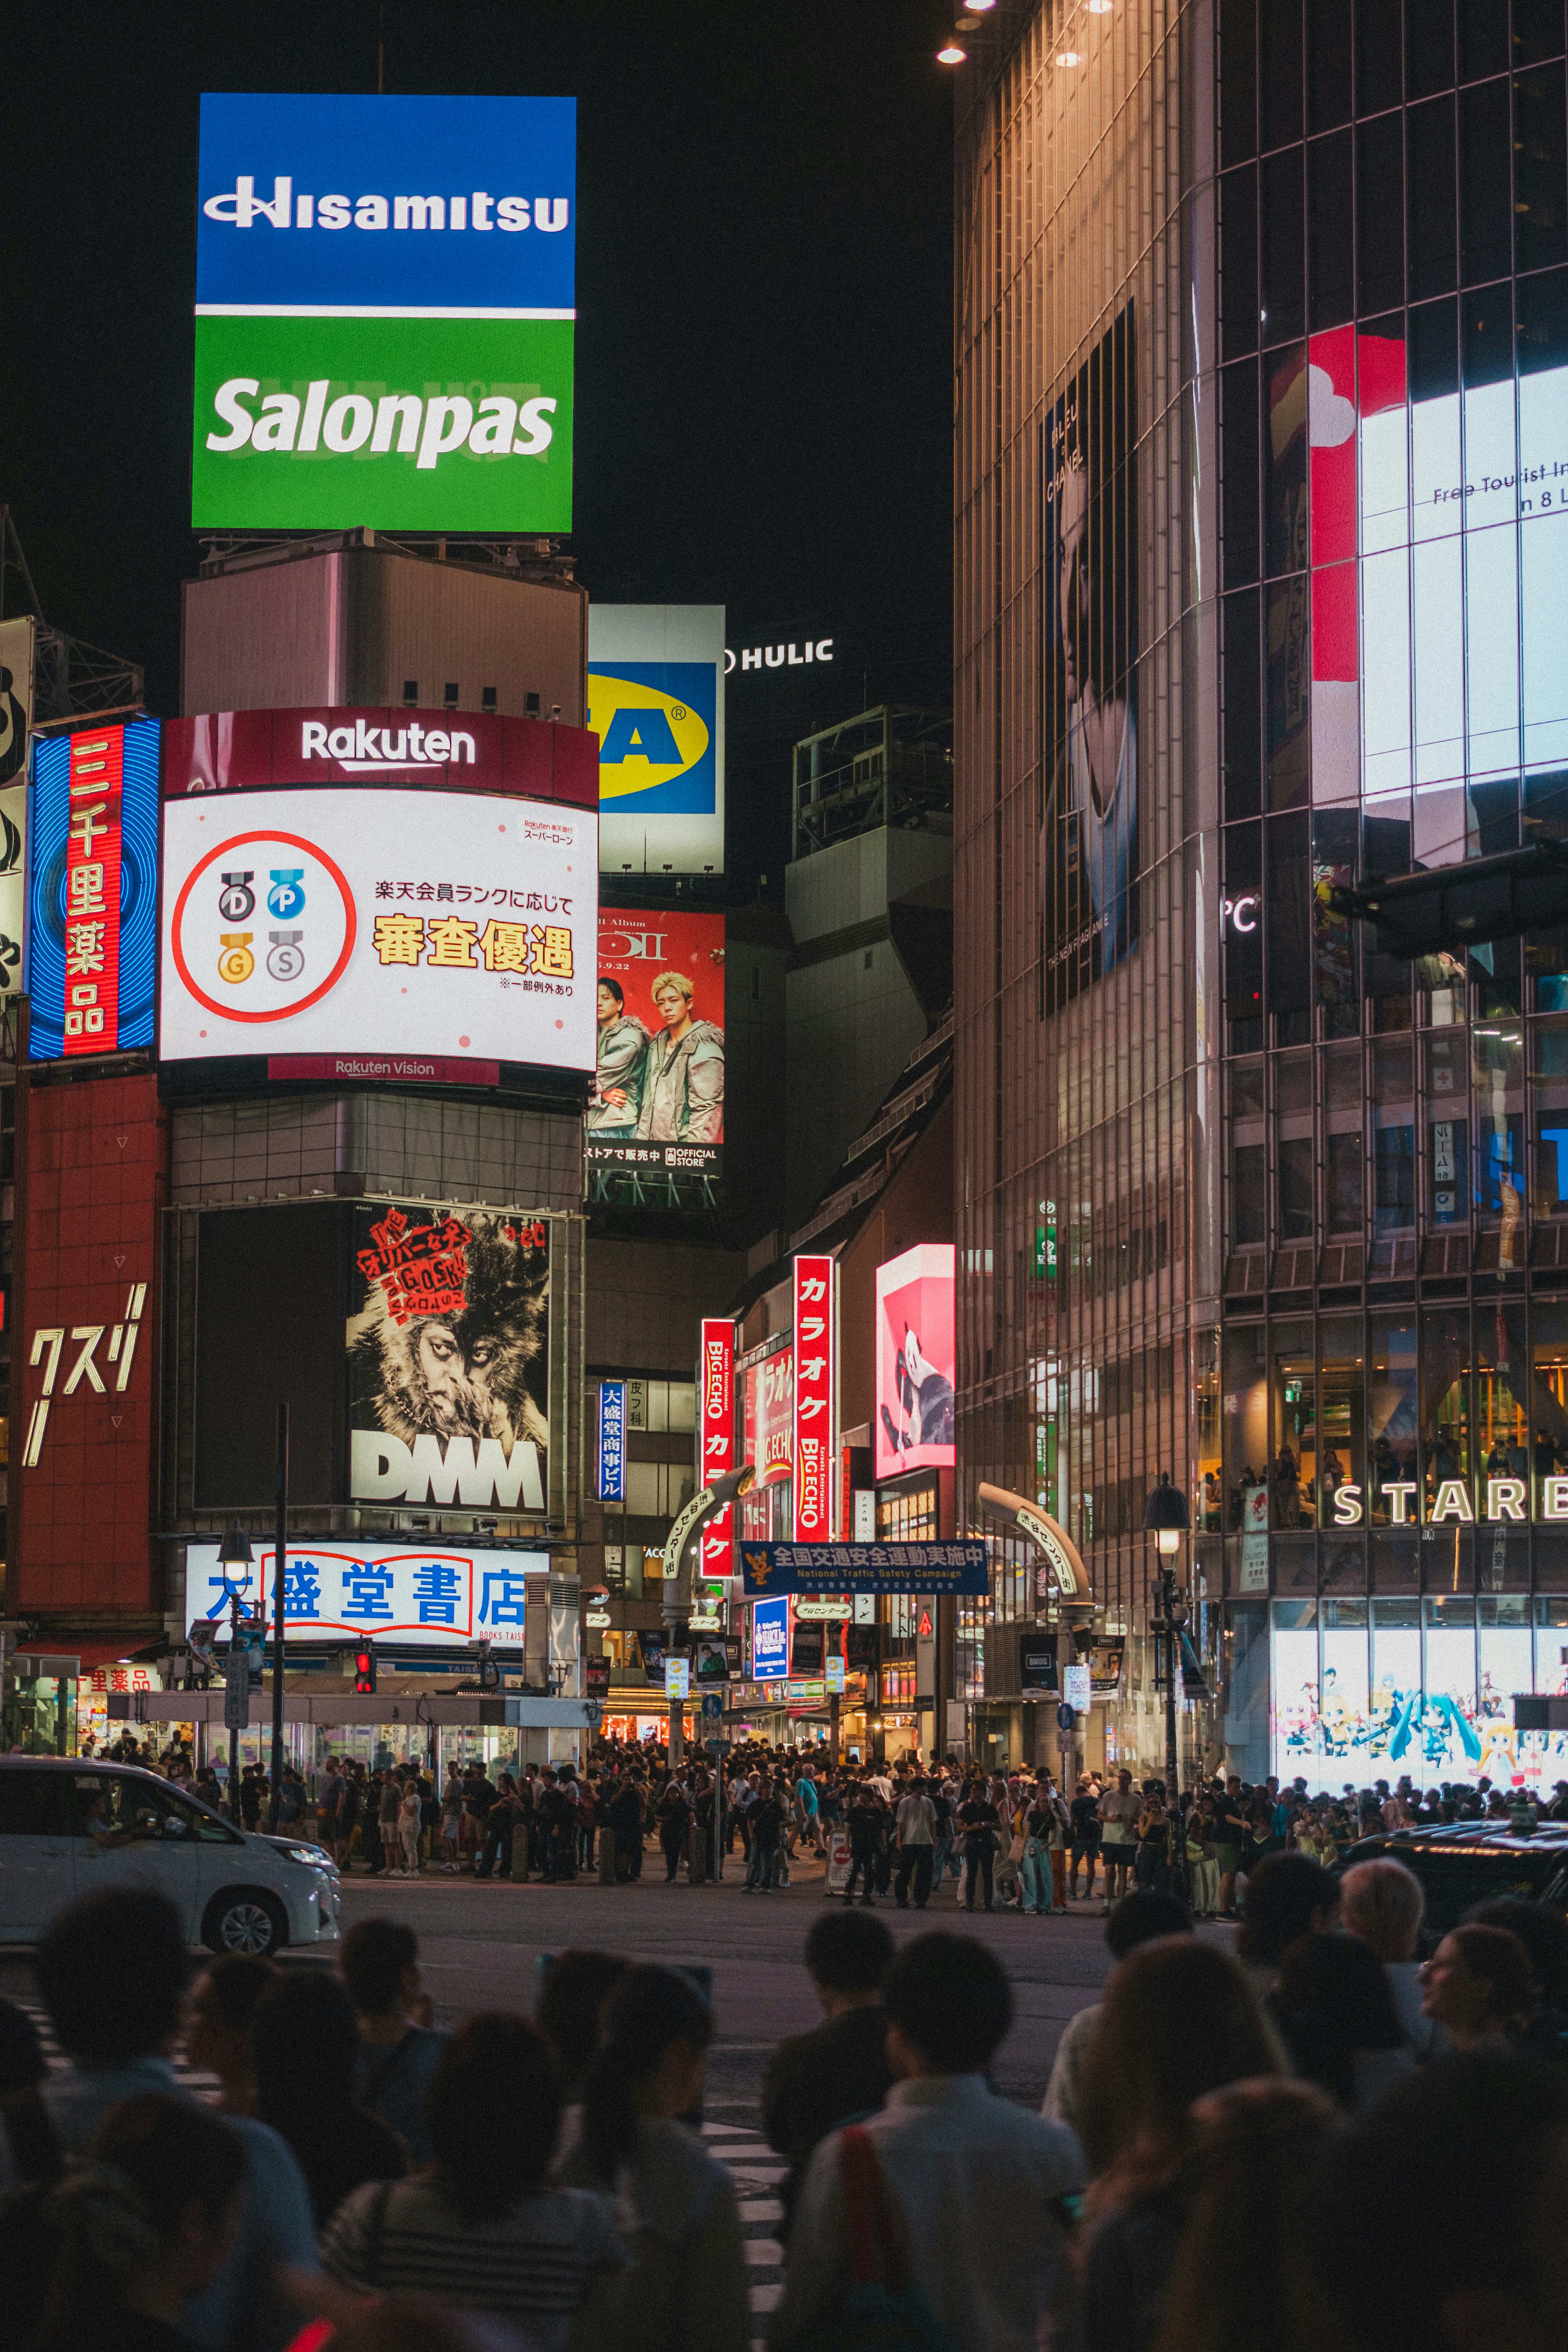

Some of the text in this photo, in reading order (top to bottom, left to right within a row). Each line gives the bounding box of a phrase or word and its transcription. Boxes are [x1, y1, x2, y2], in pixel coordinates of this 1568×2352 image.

[204, 176, 568, 232] Hisamitsu
[205, 378, 557, 469] Salonpas
[1433, 485, 1475, 504] Free
[1482, 464, 1545, 493] Touist
[1542, 492, 1551, 507] 8
[742, 639, 833, 670] HULIC
[302, 718, 475, 772] Rakuten
[524, 820, 550, 830] Rakuten
[65, 741, 110, 1036] 三千里薬品
[230, 891, 248, 915] D
[279, 890, 296, 912] P
[375, 880, 573, 915] 楽天会員ランクに応じて
[611, 919, 646, 927] Album
[1073, 912, 1108, 951] FRAGANCE
[372, 913, 574, 979] 審査優遇
[227, 954, 244, 975] G
[279, 951, 293, 973] S
[500, 977, 573, 996] ※一部例外あり
[335, 1060, 434, 1077] Rakuten Vision
[676, 1148, 717, 1159] OFFICIAL
[676, 1158, 704, 1167] STORE
[798, 1277, 827, 1420] カラオケ
[707, 1341, 723, 1419] BIG ECHO
[630, 1381, 642, 1426] 皮フ科
[603, 1389, 622, 1496] 大盛堂商事ビル
[801, 1438, 819, 1528] BIG ECHO
[666, 1493, 708, 1576] 渋谷センター街
[773, 1546, 983, 1567] 全国交通安全運動実施中
[1021, 1513, 1071, 1590] 渋谷センター街
[798, 1569, 962, 1579] National Traffic Safety Campaign
[206, 1560, 524, 1625] 大盛堂書店
[799, 1606, 848, 1615] 渋谷センター街
[479, 1631, 502, 1640] BOOKS
[51, 1669, 151, 1692] 里薬品
